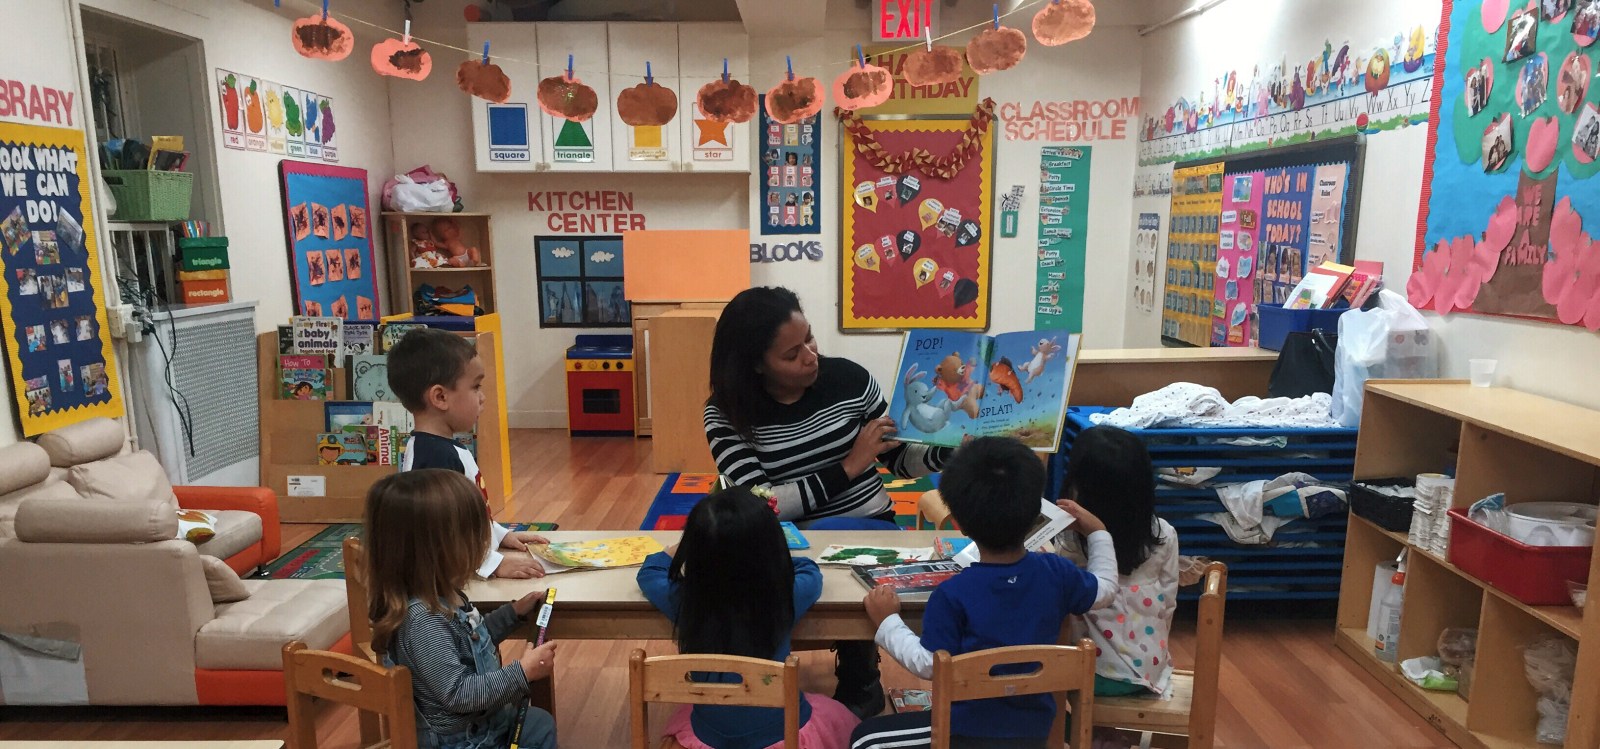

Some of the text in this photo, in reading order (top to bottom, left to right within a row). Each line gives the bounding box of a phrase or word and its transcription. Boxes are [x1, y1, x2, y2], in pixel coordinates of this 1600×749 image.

[1000, 97, 1139, 121] CLASSROOM
[1005, 119, 1128, 141] SCHEDULE
[0, 146, 78, 174] OOK WHAT
[494, 151, 525, 159] square
[0, 173, 69, 196] WE CAN
[1296, 172, 1307, 192] IN
[528, 191, 633, 211] KITCHEN
[1523, 184, 1542, 205] WE
[1267, 200, 1302, 220] SCHOOL
[547, 213, 646, 233] CENTER
[1266, 224, 1301, 244] TODAY?
[192, 258, 222, 266] triangle
[750, 241, 823, 263] BLOCKS
[1504, 245, 1547, 266] FAMILY
[188, 288, 224, 298] rectangle
[298, 339, 338, 348] animals
[304, 328, 330, 340] baby
[915, 337, 943, 350] POP!
[980, 404, 1013, 418] SPLAT!
[380, 428, 390, 466] Animal
